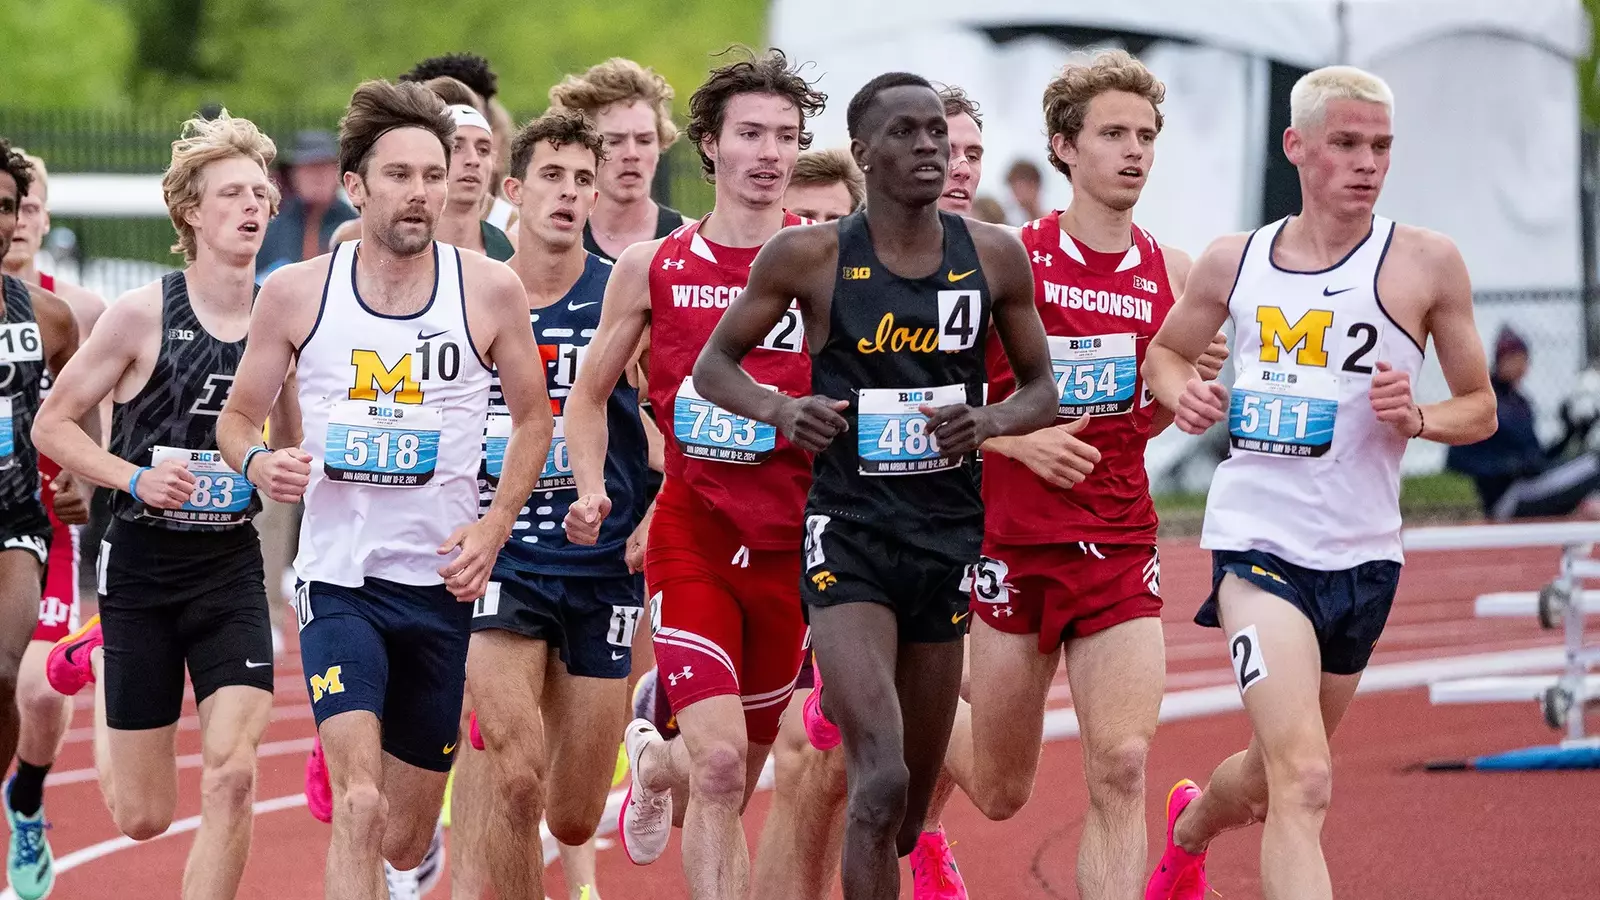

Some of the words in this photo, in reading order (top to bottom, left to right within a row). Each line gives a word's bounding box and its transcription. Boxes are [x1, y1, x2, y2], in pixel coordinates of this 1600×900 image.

[671, 285, 747, 309] WISCO
[1043, 280, 1153, 324] WISCONSIN
[0, 328, 38, 353] 16
[758, 311, 797, 350] 2
[857, 312, 960, 354] Iow
[944, 295, 974, 346] 4
[1256, 305, 1334, 367] M
[415, 341, 460, 382] 10
[1341, 322, 1378, 375] 2
[348, 349, 425, 405] M
[1053, 362, 1118, 400] 754
[688, 404, 756, 446] 753
[1106, 403, 1118, 412] 2024
[1240, 395, 1310, 440] 511
[344, 429, 420, 470] 518
[720, 449, 730, 458] MAY
[743, 452, 756, 461] 2024
[877, 418, 938, 455] 48
[1298, 445, 1312, 456] 2024
[342, 472, 354, 480] ANN
[354, 473, 371, 482] ARBOR,
[382, 474, 392, 483] MAY
[405, 475, 417, 484] 2024
[917, 461, 928, 470] MAY
[189, 475, 235, 508] 83
[977, 557, 1000, 600] 5
[1231, 634, 1261, 688] 2
[310, 666, 345, 704] M
